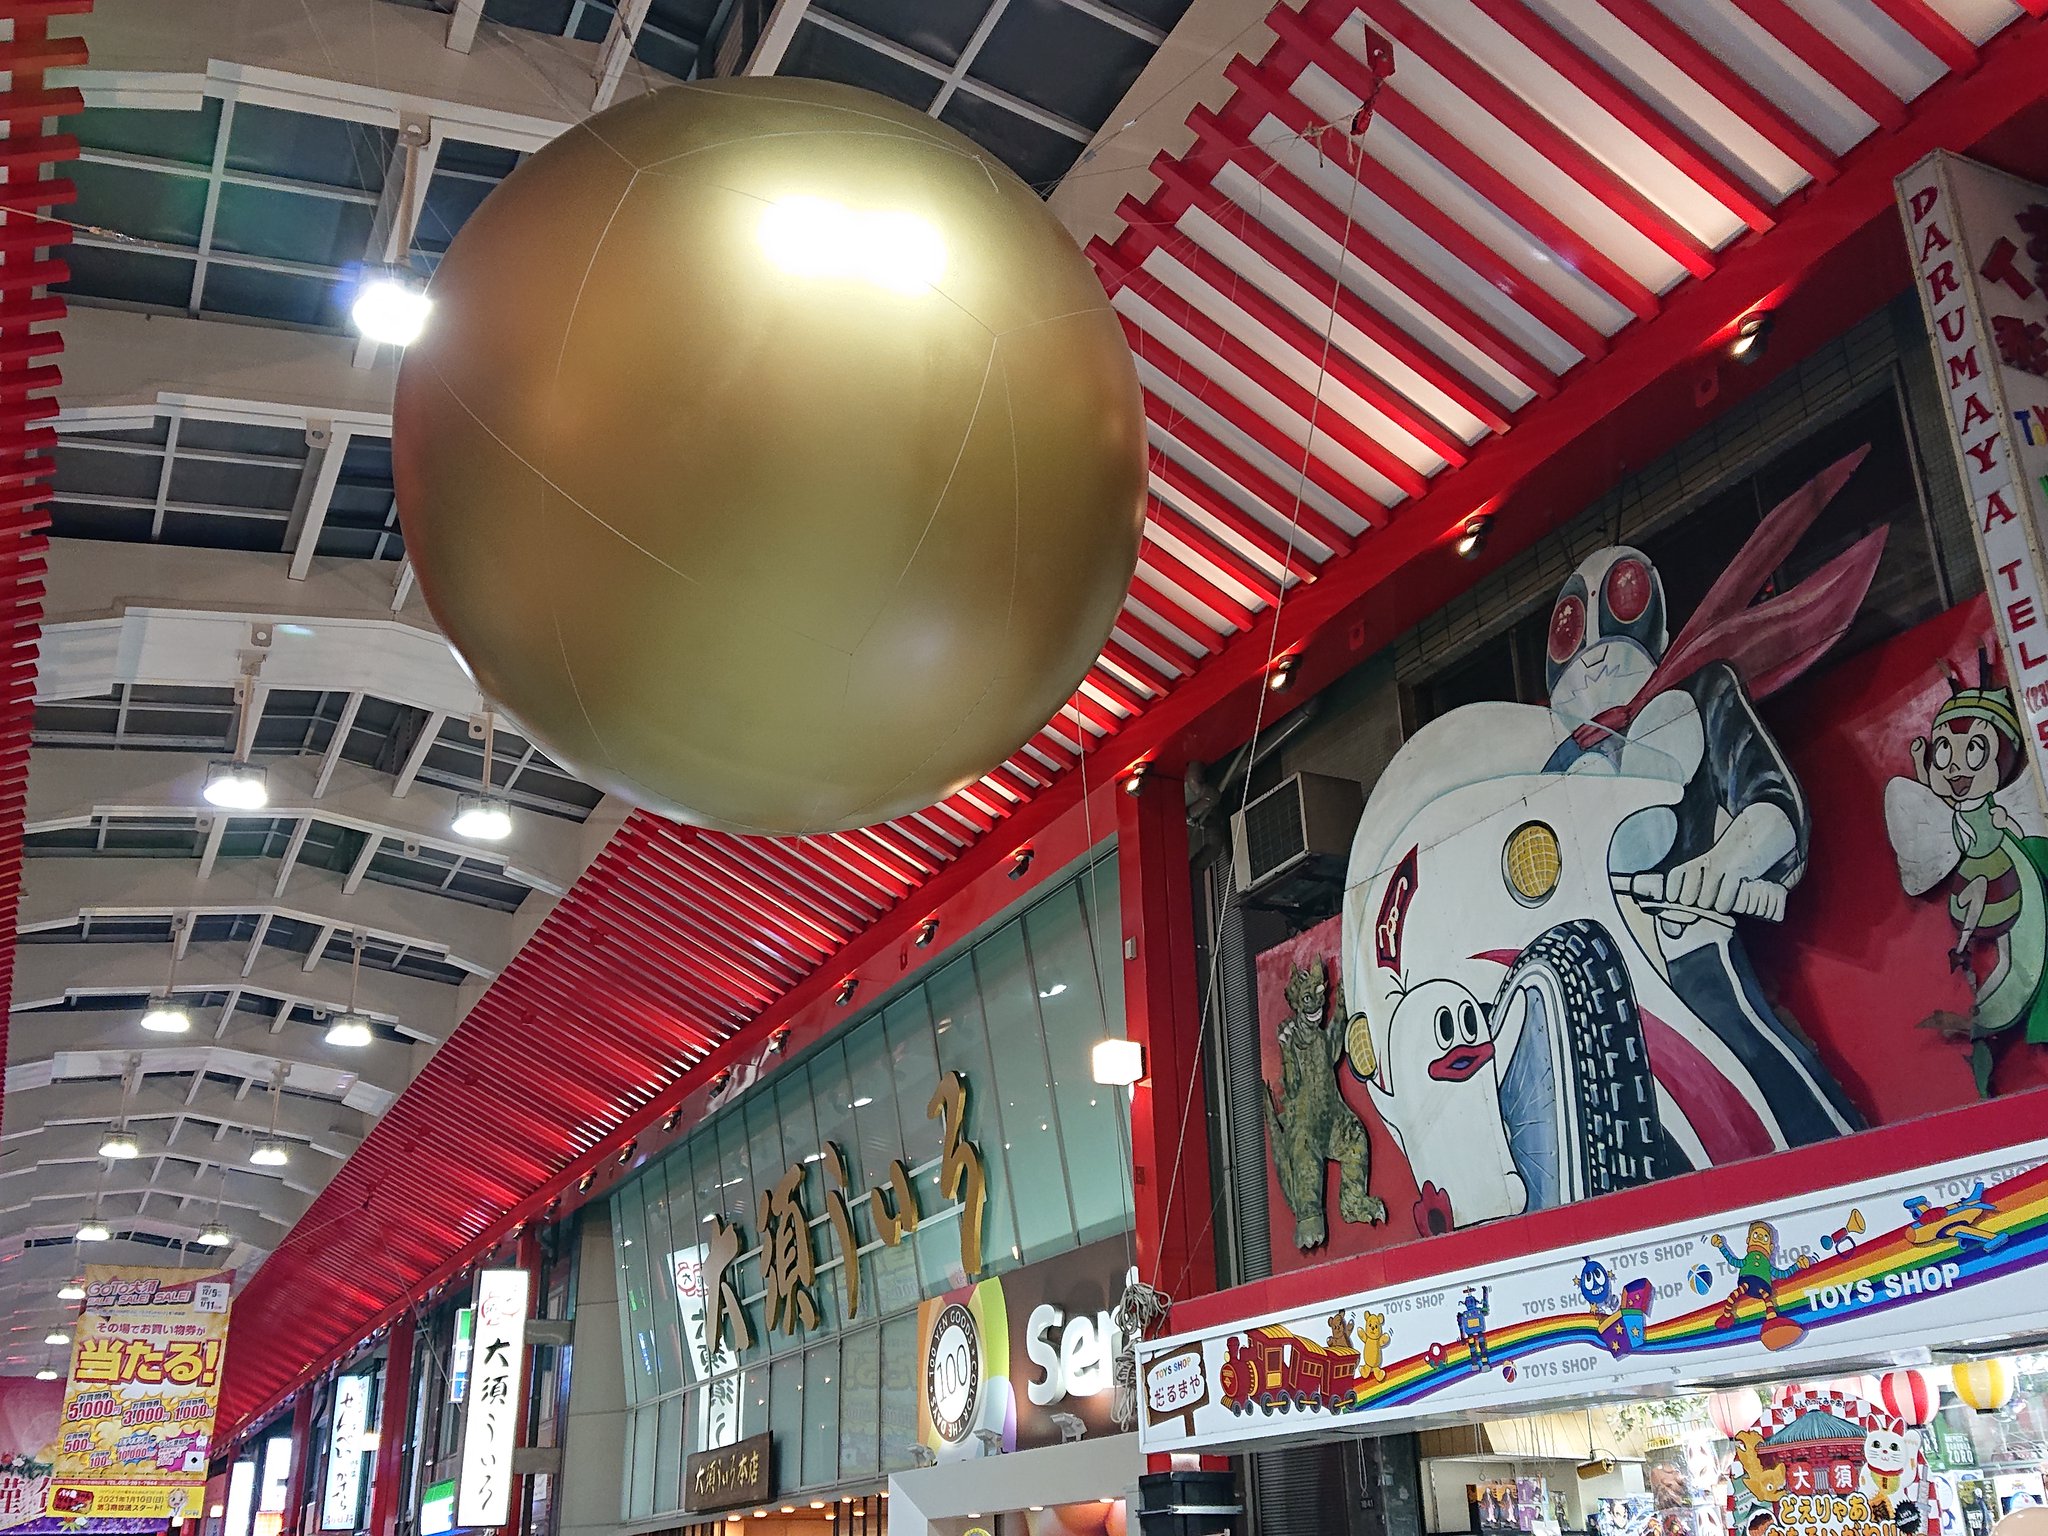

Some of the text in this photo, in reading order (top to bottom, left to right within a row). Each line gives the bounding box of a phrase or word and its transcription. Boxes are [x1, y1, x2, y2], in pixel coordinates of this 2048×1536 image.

[1909, 185, 2017, 533] DARUMAYA
[1999, 558, 2048, 672] TEL
[1610, 1241, 1695, 1271] TOYS SHOP
[118, 1293, 150, 1305] SALE!
[153, 1290, 191, 1303] SALE!
[1804, 1262, 1961, 1312] TOYS SHOP
[1384, 1293, 1446, 1315] TOYS SHOP
[1522, 1296, 1564, 1316] TOYS
[96, 1322, 206, 1336] その場でお買い物券が
[934, 1314, 949, 1341] YEN
[950, 1310, 976, 1346] GOODS
[74, 1338, 222, 1386] 当たる!
[936, 1344, 968, 1403] 100
[1155, 1356, 1192, 1380] TOYS SHOP
[1522, 1356, 1598, 1379] TOYS SHOP
[962, 1364, 978, 1421] COLOR
[1154, 1374, 1201, 1408] だるまや
[479, 1338, 511, 1511] 大須ういろ
[930, 1396, 948, 1436] DAYS
[948, 1420, 963, 1438] THE
[1780, 1495, 1869, 1526] どえりゃあ
